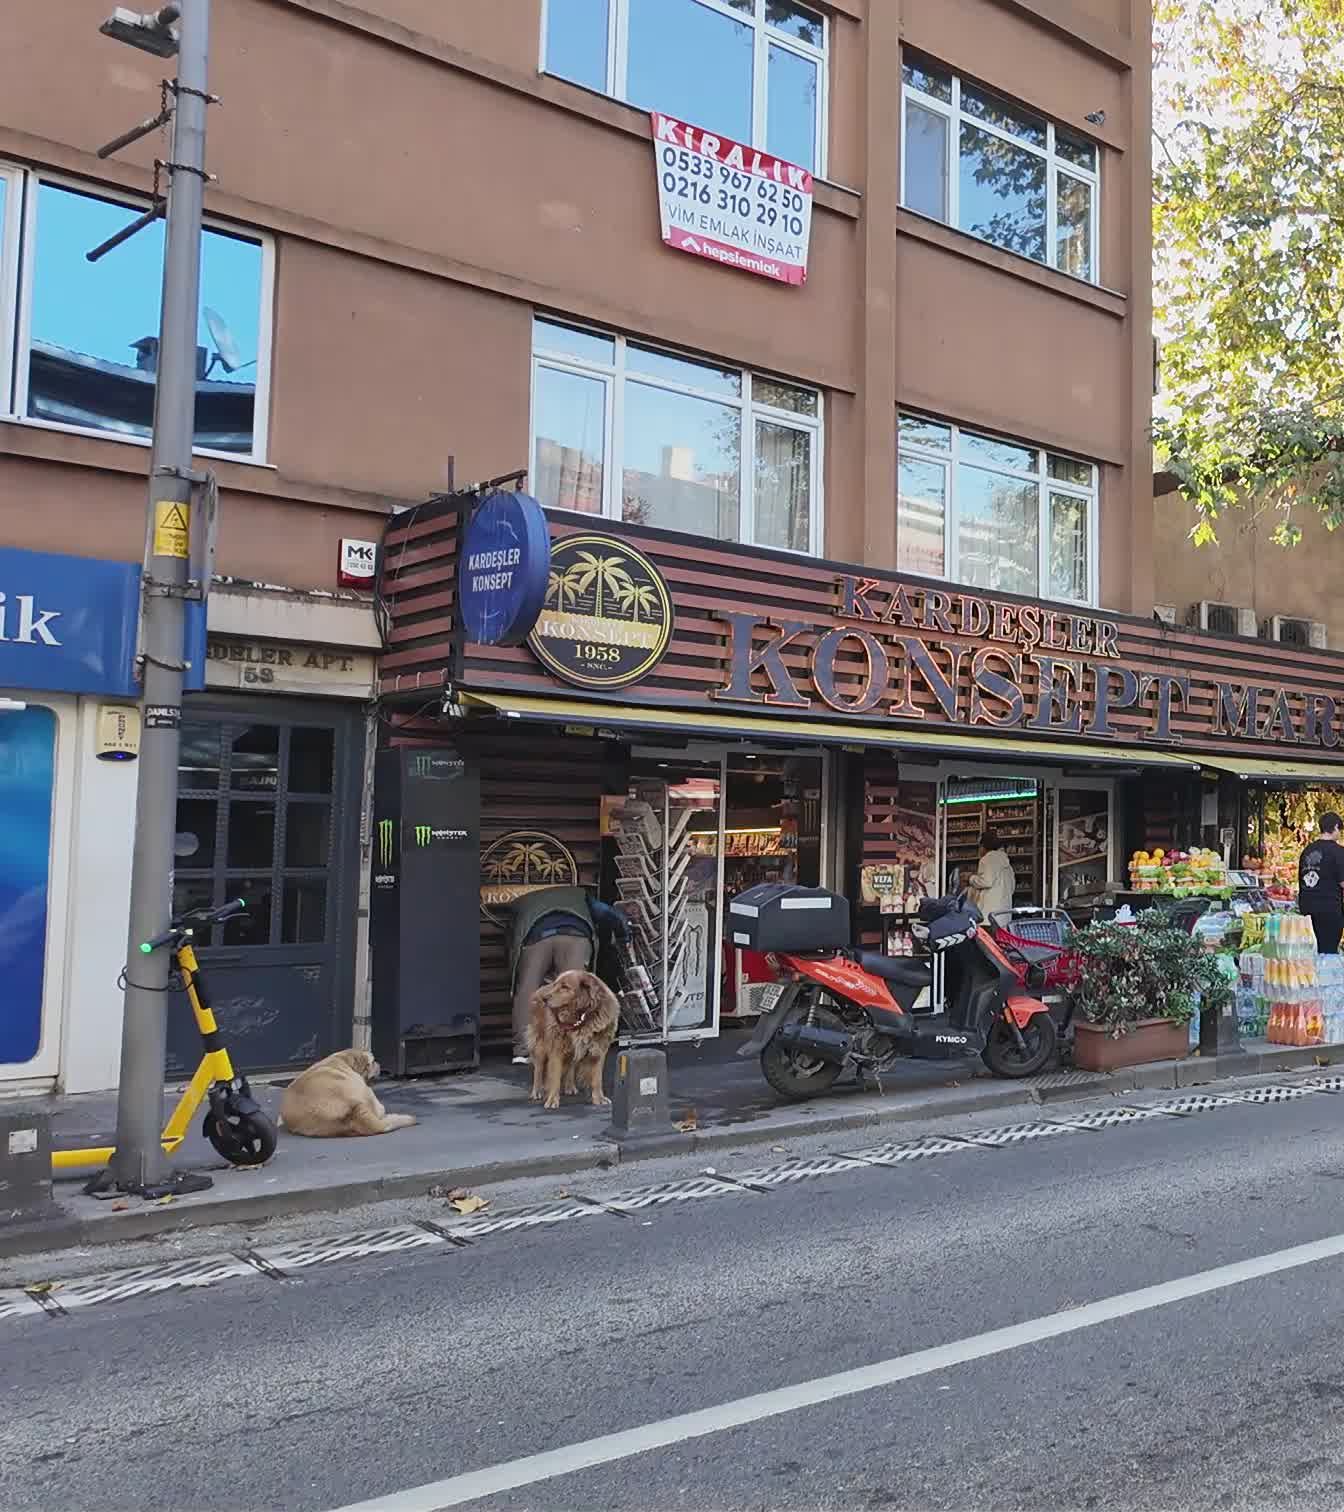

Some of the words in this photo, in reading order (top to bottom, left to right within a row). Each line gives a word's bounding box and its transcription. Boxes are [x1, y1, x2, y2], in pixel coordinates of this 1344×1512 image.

[657, 115, 805, 191] KİRALIK
[662, 147, 714, 180] 0533
[719, 166, 752, 193] 967
[757, 180, 777, 205] 62
[782, 189, 803, 213] 50
[662, 172, 711, 205] 0216
[717, 189, 750, 217] 310
[756, 203, 777, 227] 29
[782, 214, 803, 236] 10
[700, 215, 750, 244] EMLAK
[753, 228, 803, 260] İNŞAAT
[703, 242, 781, 277] hepsiemlak
[468, 548, 520, 571] KARDEŞLER
[472, 571, 513, 592] KONSEPT
[0, 591, 63, 647] ik
[542, 619, 653, 649] KONSEPT
[833, 574, 1120, 659] KARDEŞLER
[207, 642, 293, 666] DELER
[303, 652, 353, 672] APT.
[575, 644, 620, 663] 1958
[710, 608, 1191, 746] KONSEPT
[935, 1035, 968, 1044] KYMCO
